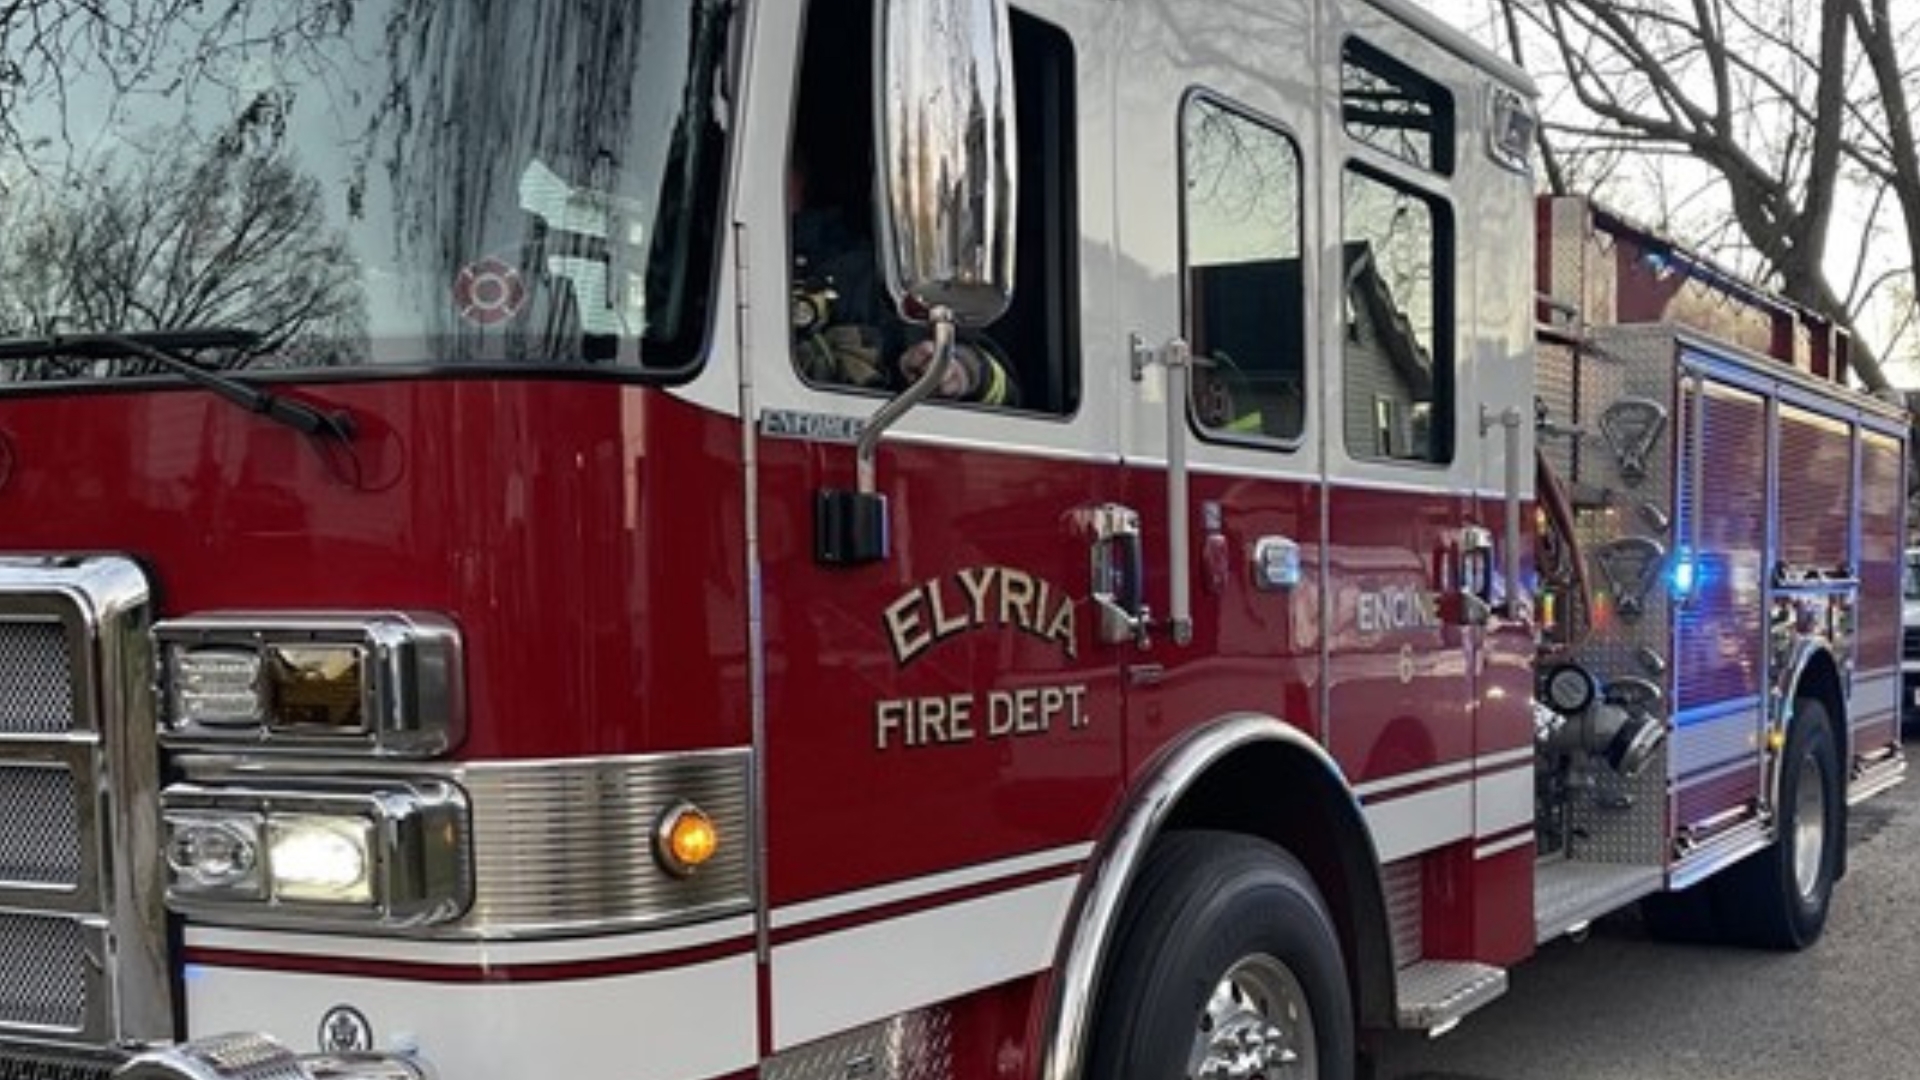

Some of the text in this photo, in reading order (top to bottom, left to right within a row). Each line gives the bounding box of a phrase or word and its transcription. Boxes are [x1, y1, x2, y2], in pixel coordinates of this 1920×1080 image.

[762, 411, 868, 438] ENFORCE
[885, 566, 1078, 664] ELYRIA
[1358, 591, 1441, 631] ENGINE
[1399, 642, 1413, 684] 6
[876, 684, 1090, 750] FIRE DEPT.
